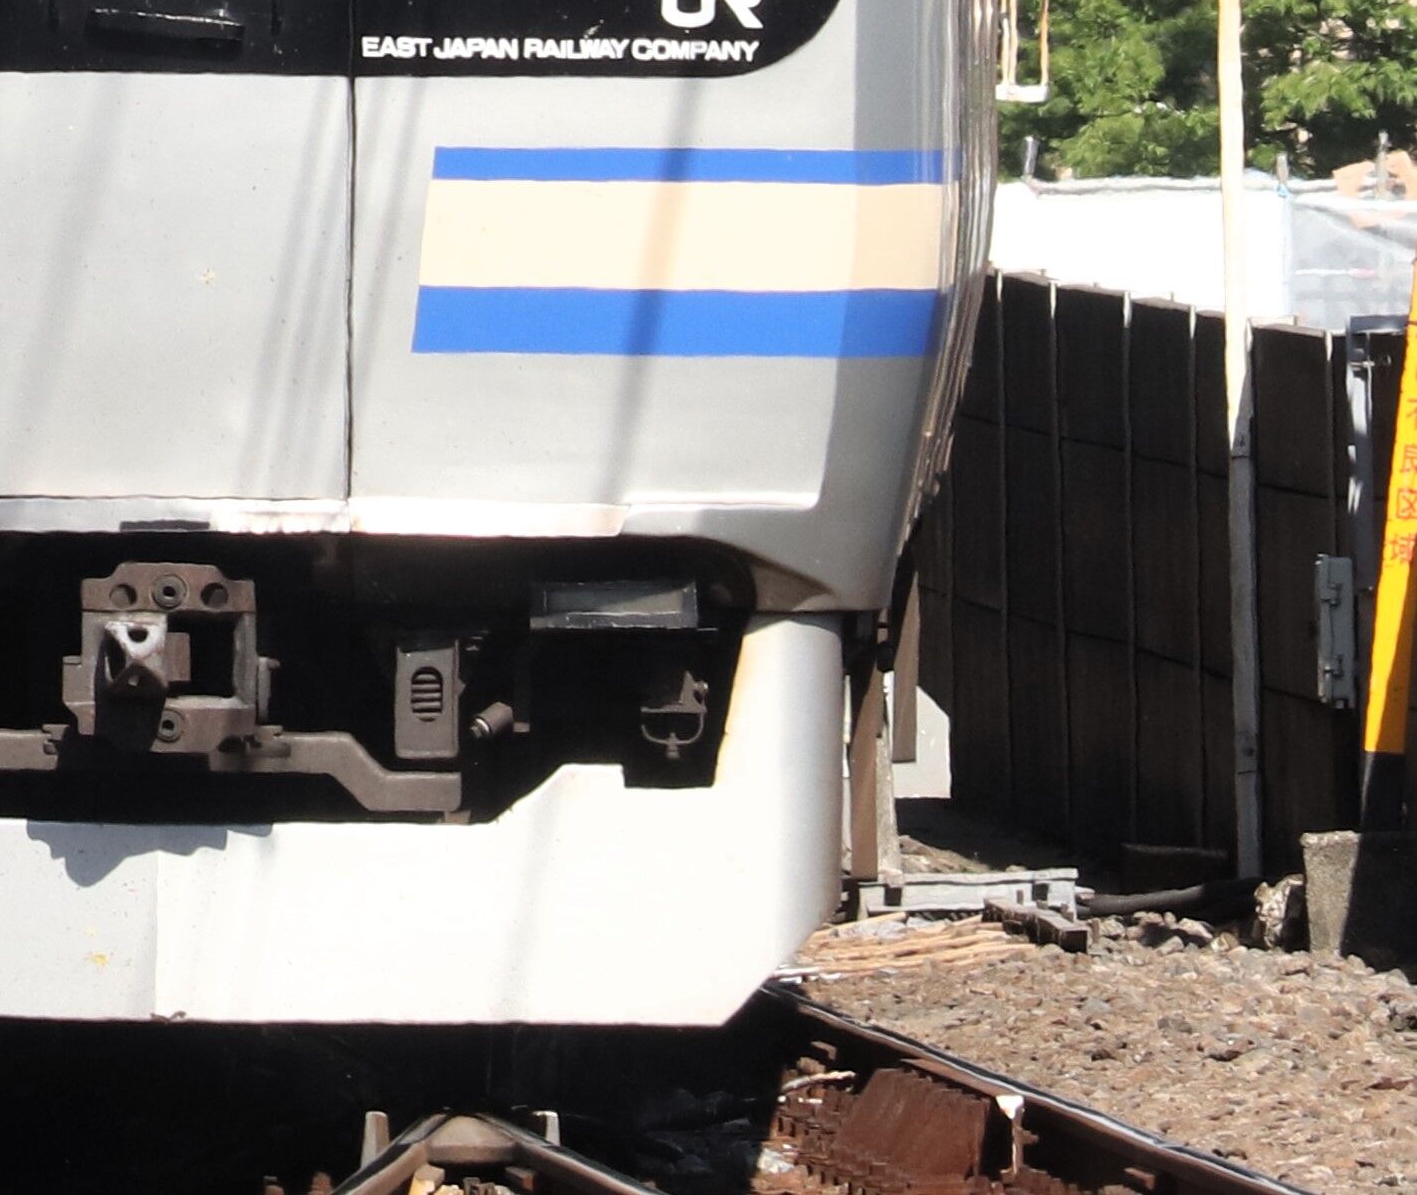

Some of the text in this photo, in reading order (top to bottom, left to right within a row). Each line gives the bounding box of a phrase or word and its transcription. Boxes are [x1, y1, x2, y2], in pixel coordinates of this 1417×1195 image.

[361, 35, 760, 62] EAST JAPAN RAILWAY COMPANY
